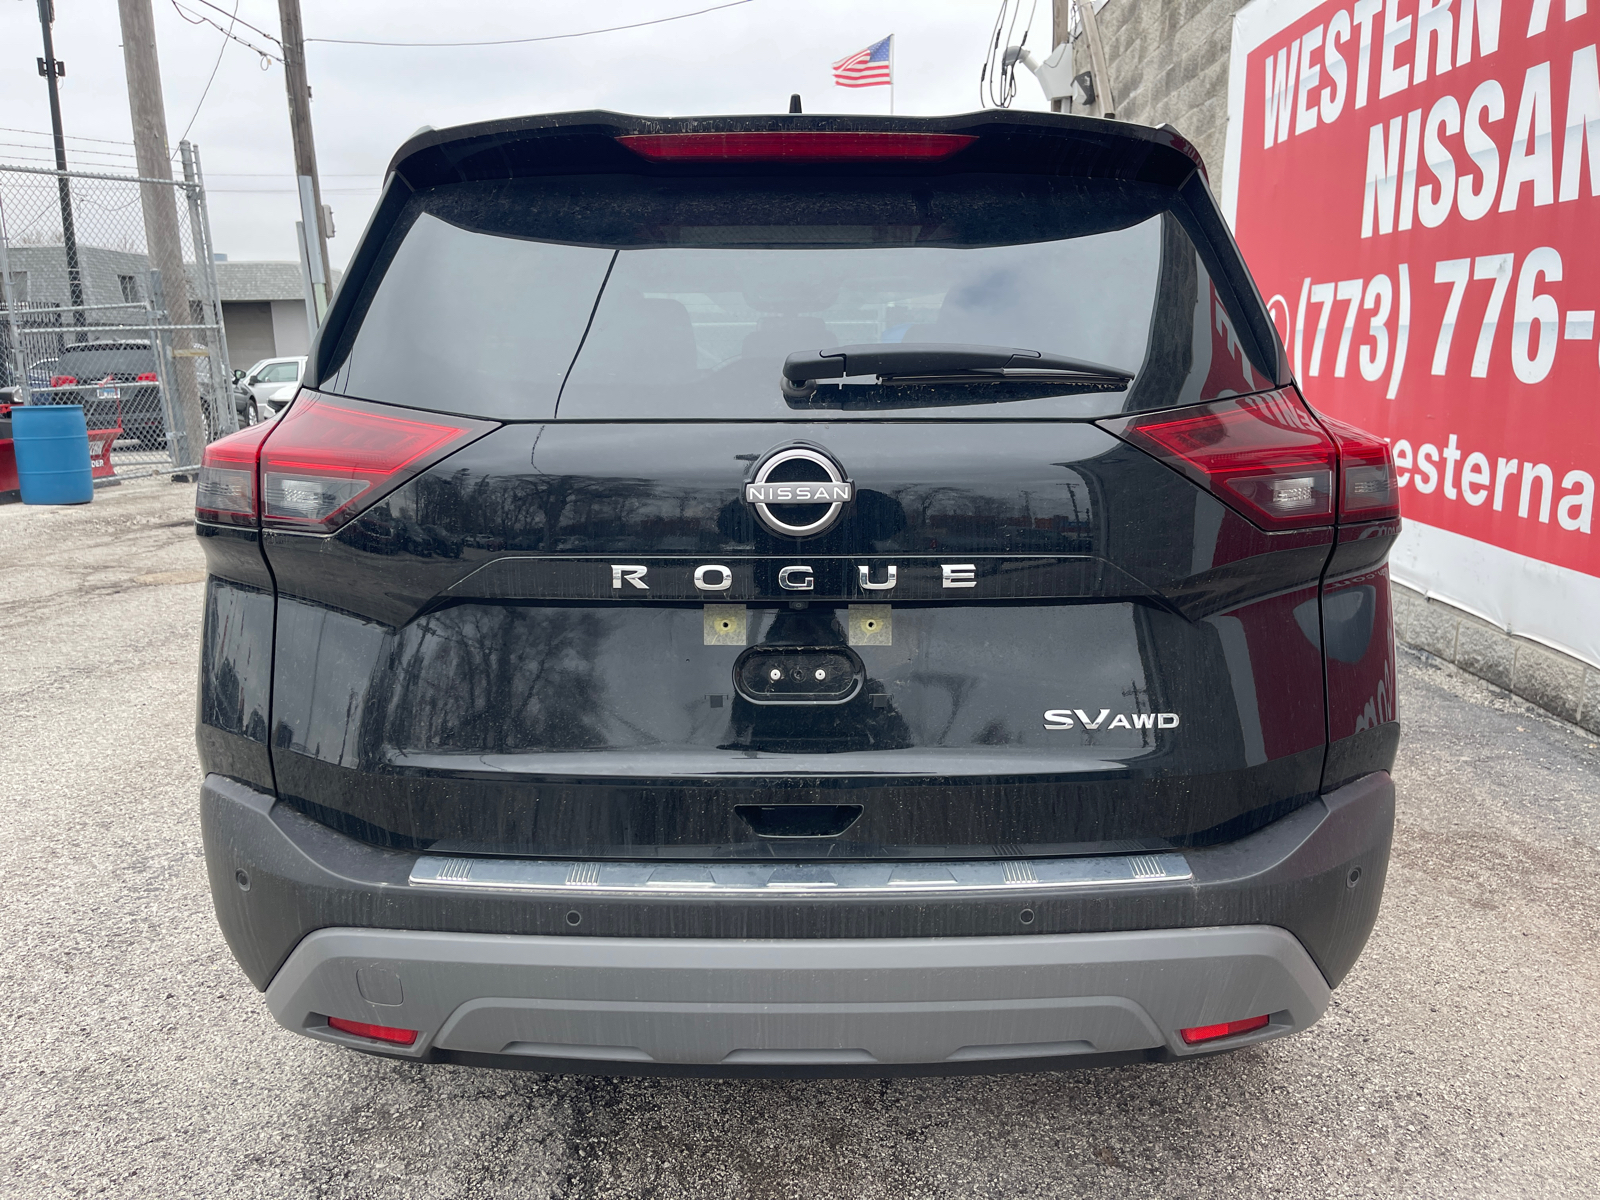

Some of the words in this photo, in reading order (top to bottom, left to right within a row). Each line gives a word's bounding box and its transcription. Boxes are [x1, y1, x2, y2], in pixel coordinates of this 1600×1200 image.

[1361, 44, 1600, 239] NISSAN
[1294, 263, 1411, 400] (773)
[1431, 246, 1600, 384] 776-
[750, 486, 849, 500] NISSAN
[1384, 434, 1595, 534] esterna
[611, 564, 977, 590] ROGUE
